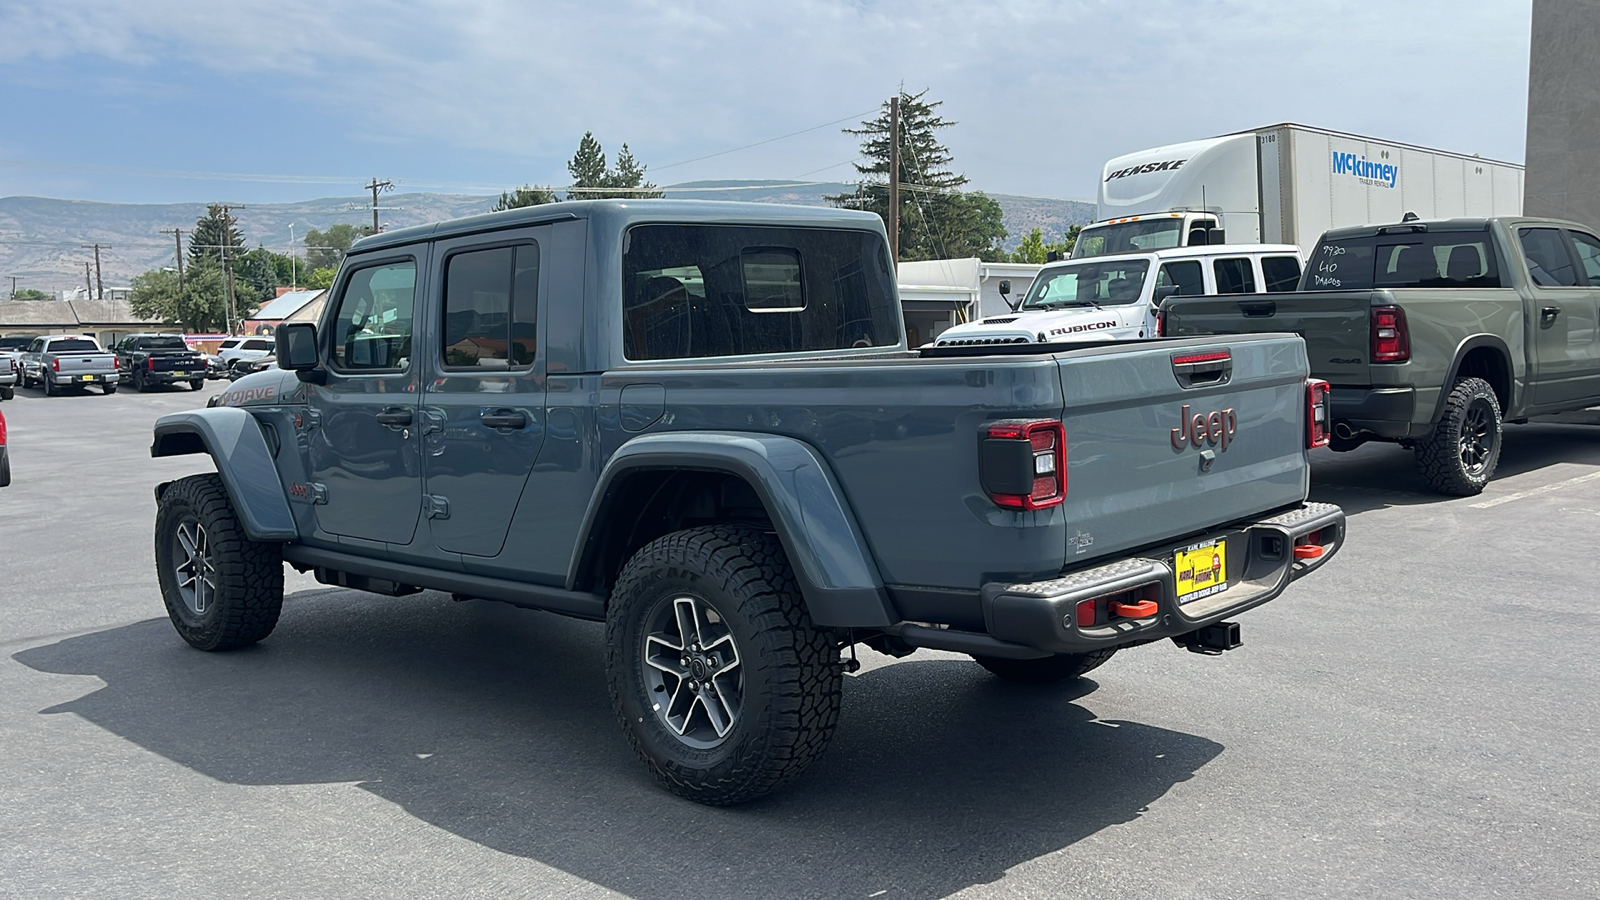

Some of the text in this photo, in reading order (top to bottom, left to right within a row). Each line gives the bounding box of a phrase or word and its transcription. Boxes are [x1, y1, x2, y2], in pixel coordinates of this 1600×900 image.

[1104, 159, 1188, 182] PENSKE
[1049, 320, 1117, 336] RUBICON
[220, 386, 275, 406] MOJAVE
[1171, 404, 1237, 453] Jeep
